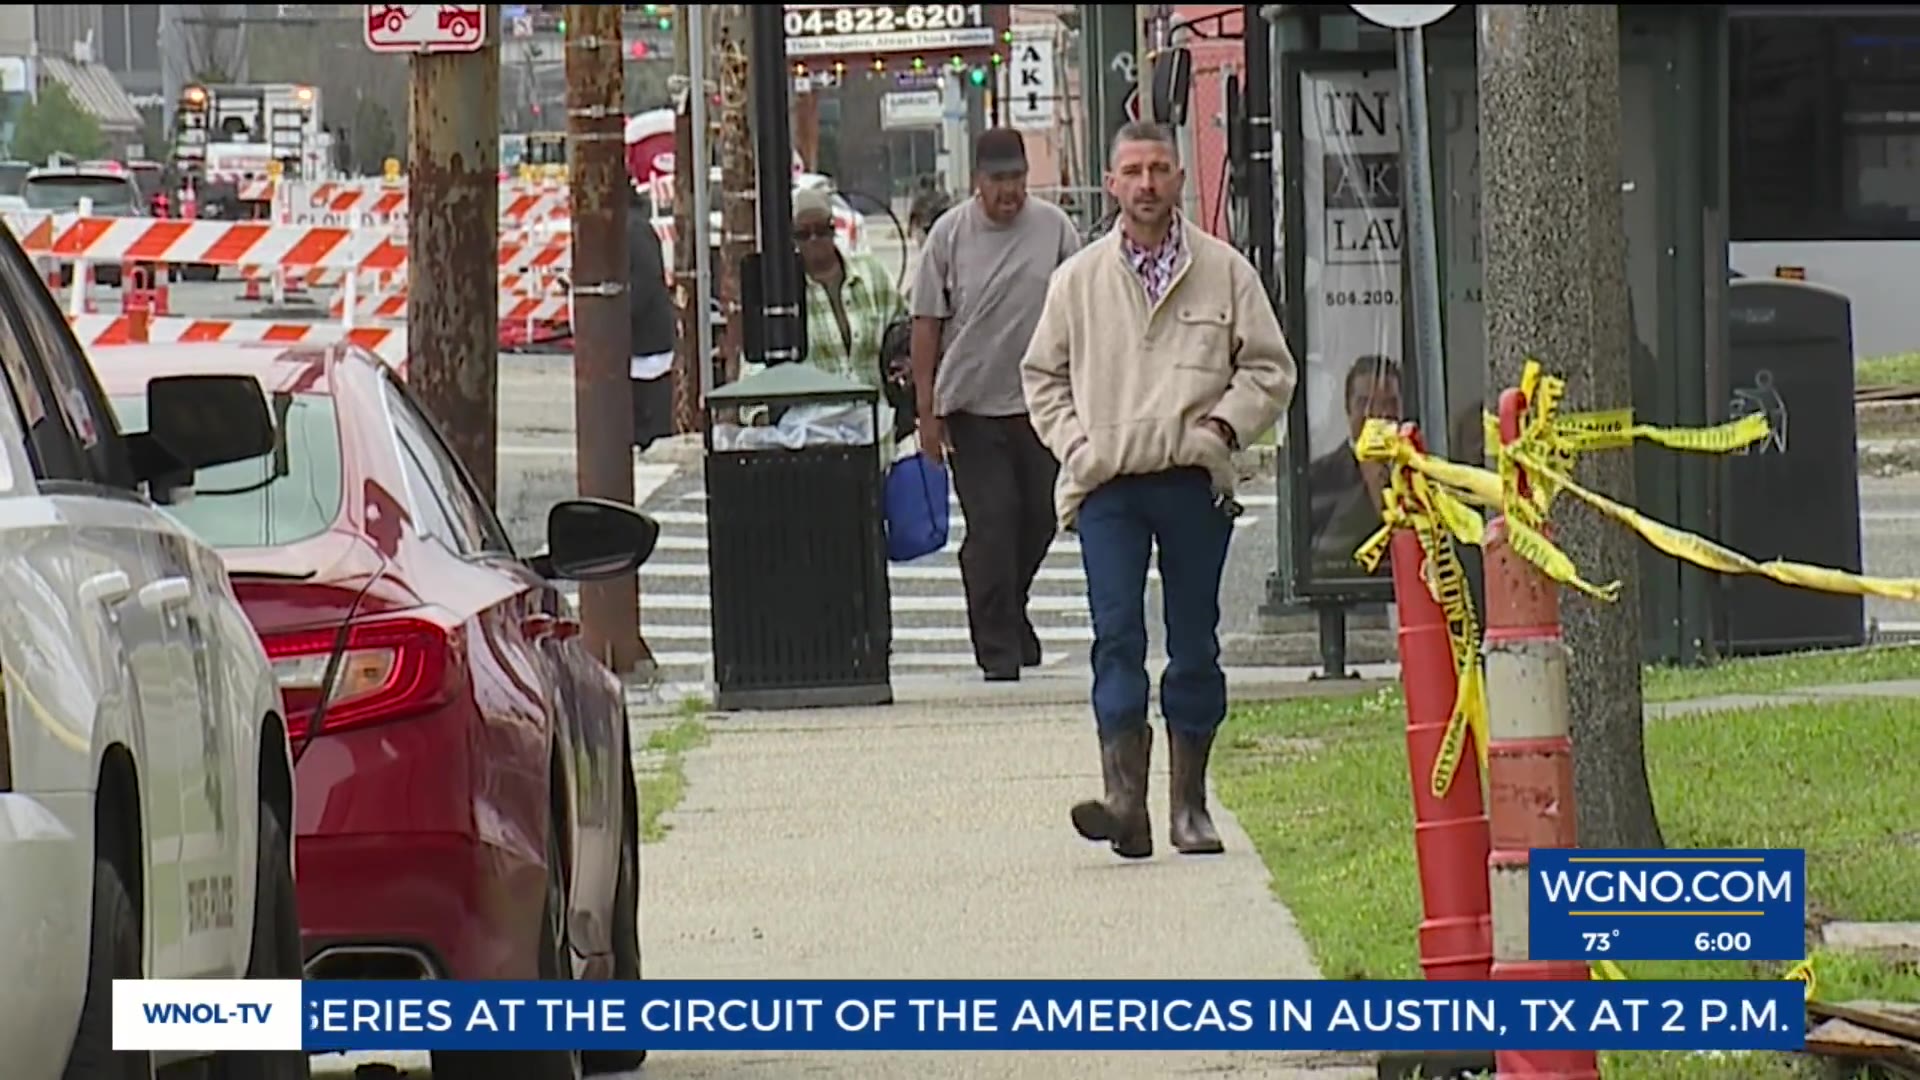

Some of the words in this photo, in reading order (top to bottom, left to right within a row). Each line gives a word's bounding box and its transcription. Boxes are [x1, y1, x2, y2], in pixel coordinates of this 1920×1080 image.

[785, 5, 982, 36] 04-822-6201
[1021, 45, 1042, 111] AKI
[1333, 163, 1399, 199] AK
[1326, 289, 1400, 307] 504.200.
